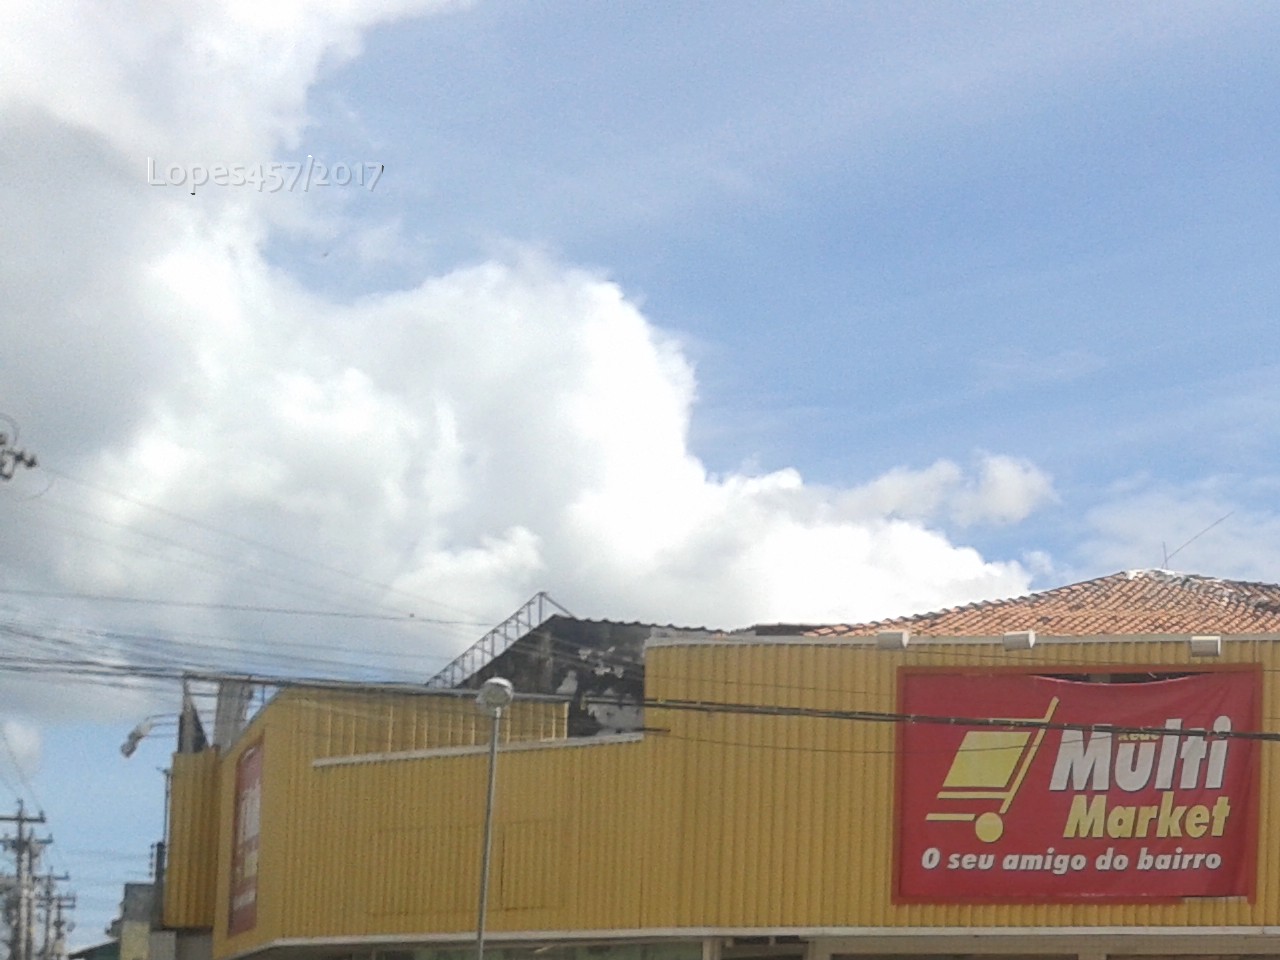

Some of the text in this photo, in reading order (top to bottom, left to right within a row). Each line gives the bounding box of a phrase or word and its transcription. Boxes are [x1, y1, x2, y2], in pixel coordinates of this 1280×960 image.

[1049, 716, 1232, 791] Multi
[1063, 791, 1231, 839] Market
[921, 847, 1222, 875] O seu amigo do bairro
